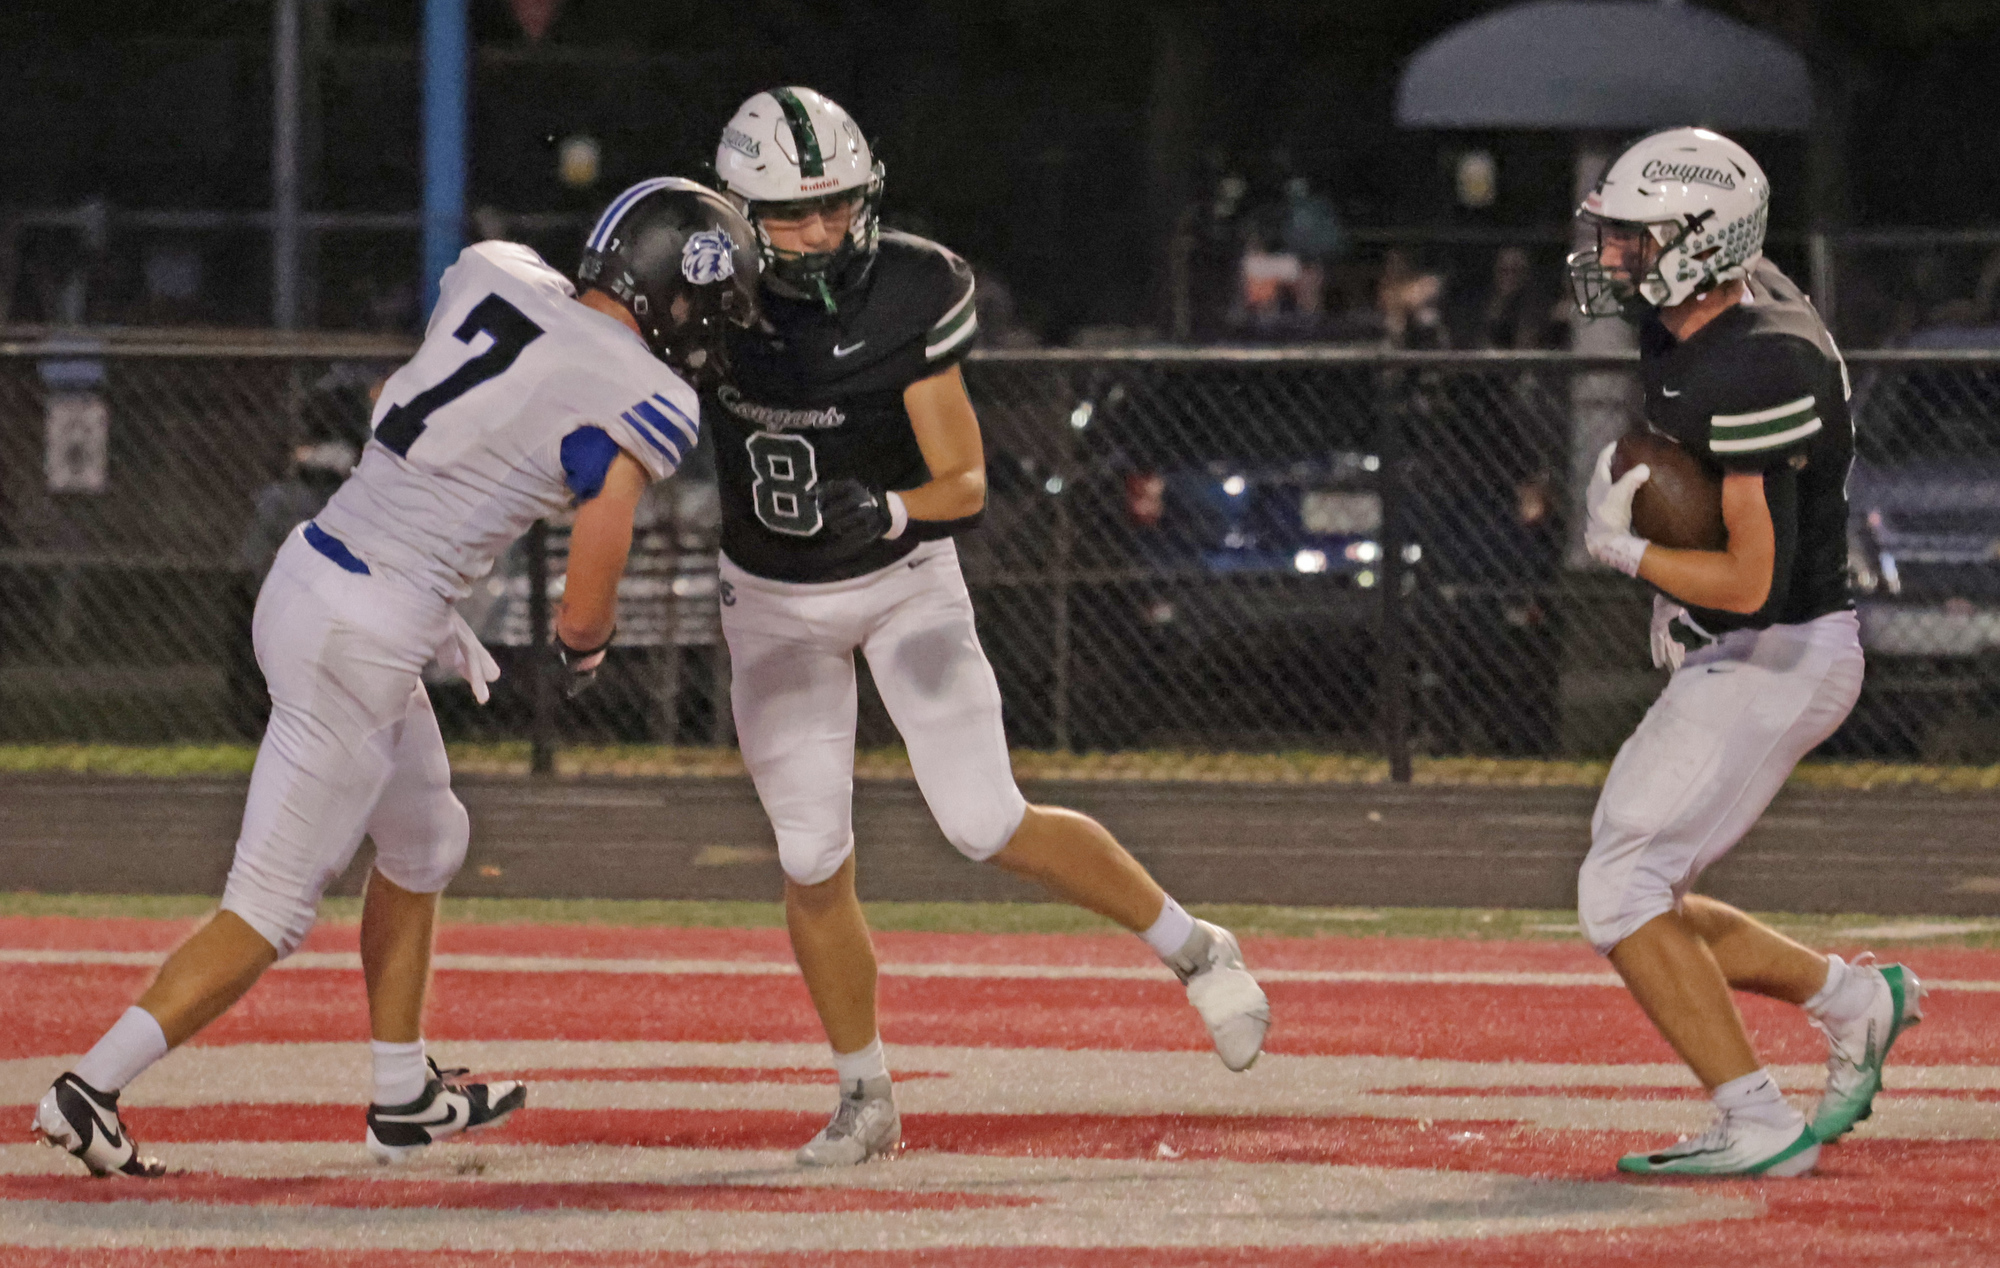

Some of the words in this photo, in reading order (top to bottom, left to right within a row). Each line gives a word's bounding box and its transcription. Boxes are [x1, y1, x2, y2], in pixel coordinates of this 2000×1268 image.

[800, 178, 839, 192] Riddell
[1641, 159, 1736, 190] Cougars
[374, 292, 546, 460] 7
[746, 430, 823, 537] 8
